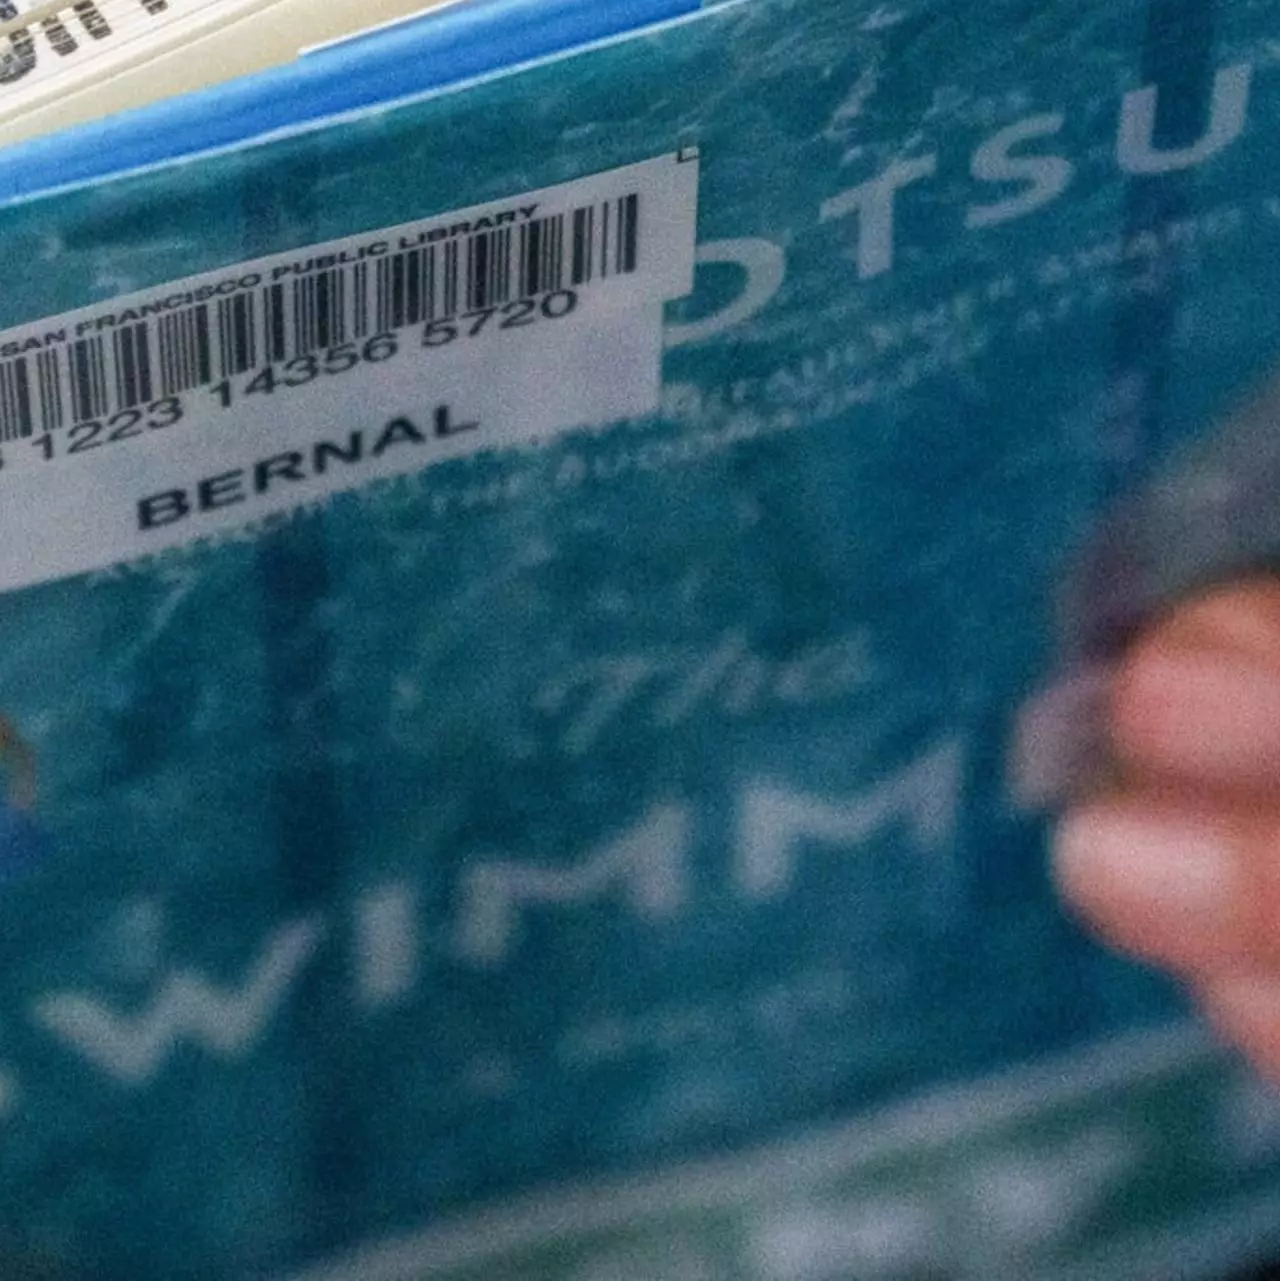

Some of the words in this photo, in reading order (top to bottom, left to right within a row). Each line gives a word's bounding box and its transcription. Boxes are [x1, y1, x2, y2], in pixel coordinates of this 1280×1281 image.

[0, 329, 67, 358] SAN
[75, 272, 263, 337] FRANCISCO
[270, 240, 390, 282] PUBLIC
[398, 203, 540, 249] LIBRARY
[31, 395, 185, 461] 1223
[209, 331, 399, 409] 14356
[421, 288, 579, 348] 5720
[136, 403, 480, 531] BERNAL
